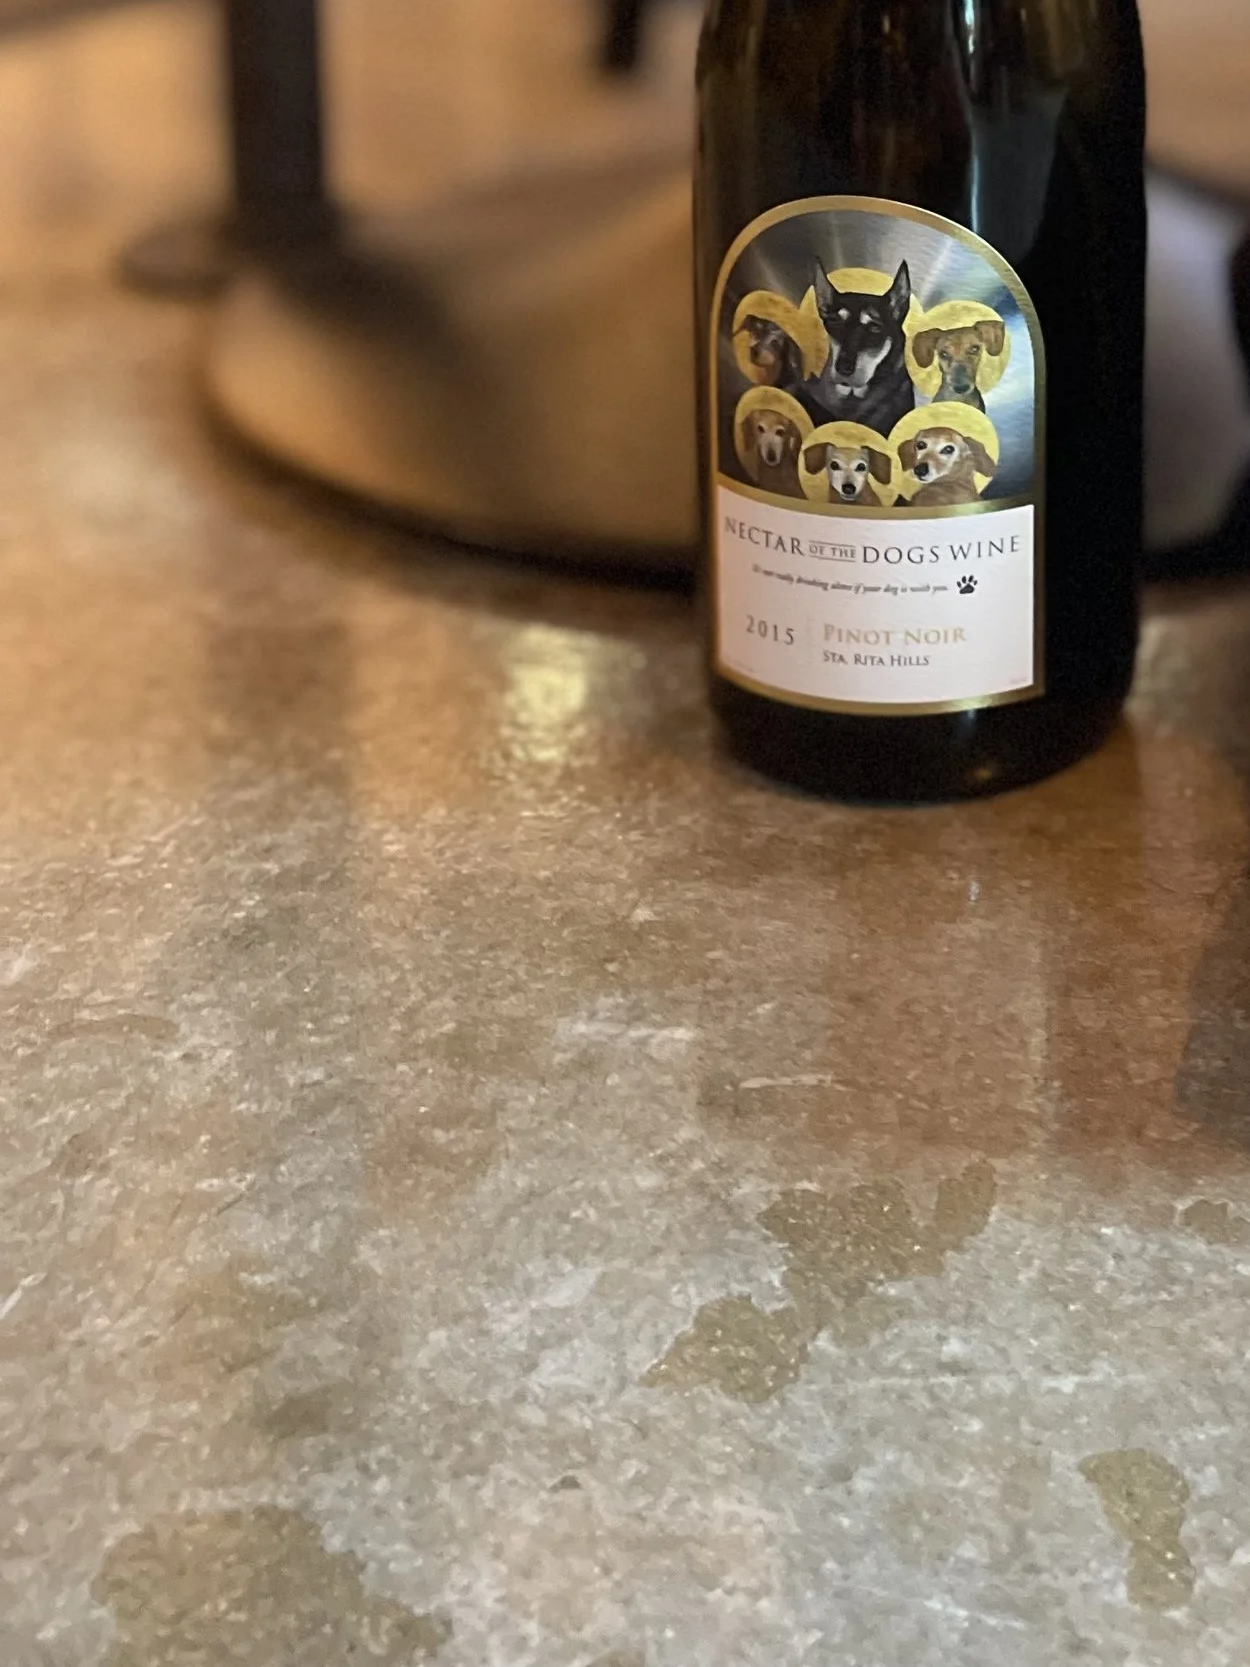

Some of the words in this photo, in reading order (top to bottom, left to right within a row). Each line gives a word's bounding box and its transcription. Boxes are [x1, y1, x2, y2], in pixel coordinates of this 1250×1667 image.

[725, 515, 805, 556] NECTAR
[809, 544, 825, 556] OF
[831, 546, 856, 559] THE
[863, 545, 940, 564] DOGS
[949, 535, 1020, 561] WINE
[745, 615, 795, 646] 2015
